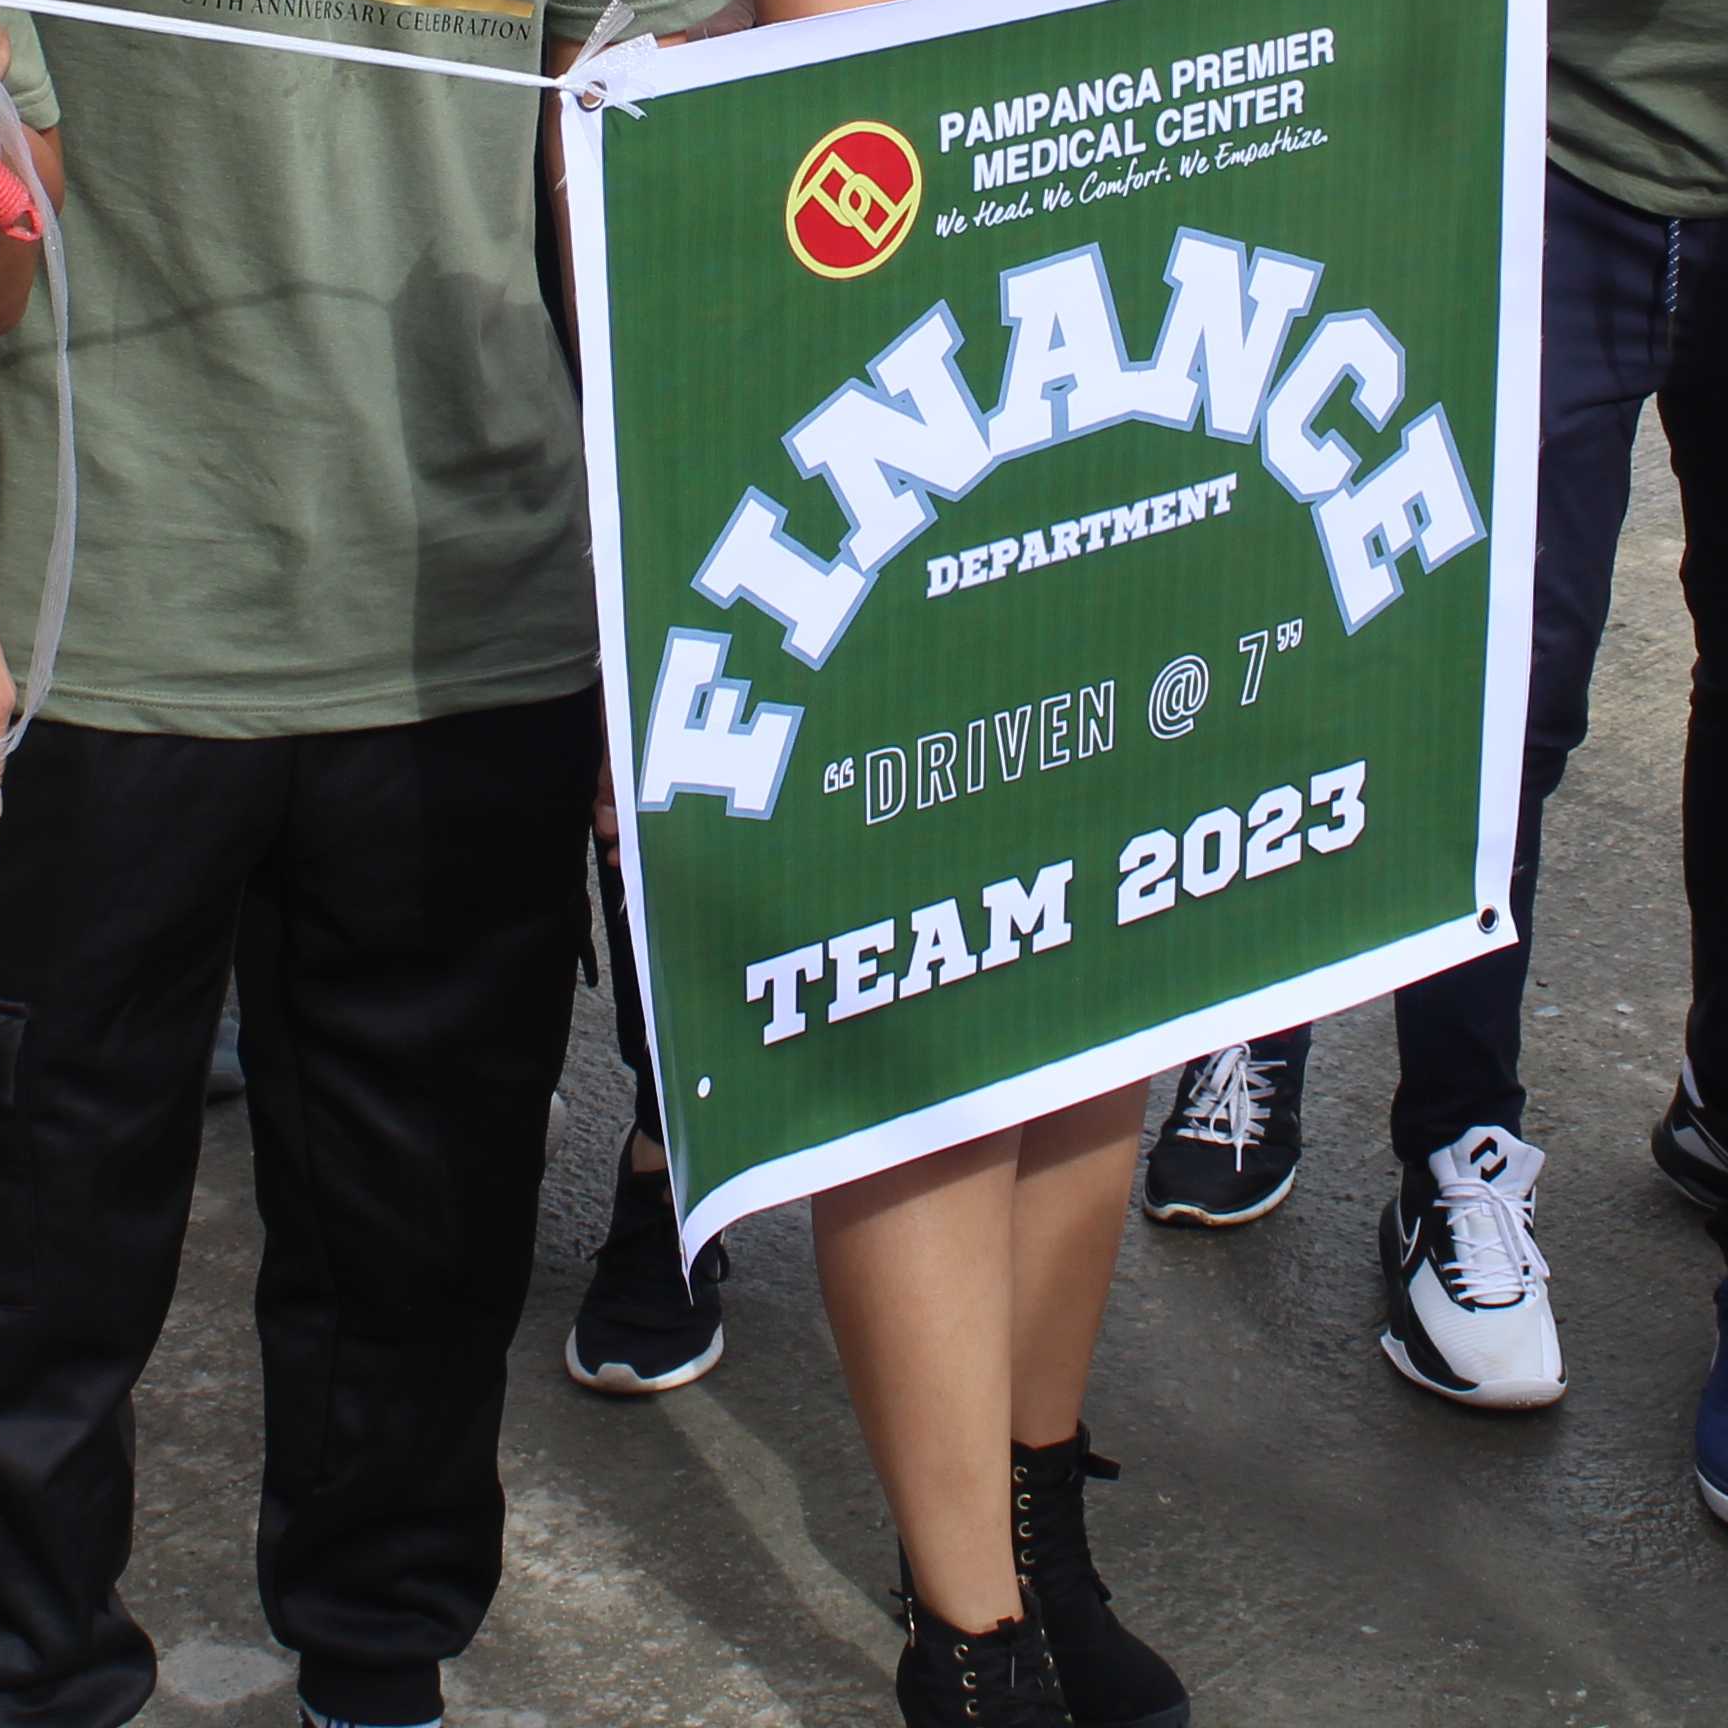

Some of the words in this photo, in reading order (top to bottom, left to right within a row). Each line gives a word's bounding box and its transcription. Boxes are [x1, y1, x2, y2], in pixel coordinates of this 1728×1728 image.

[396, 10, 533, 42] CELEBRATION
[939, 67, 1163, 154] PAMPANGA
[1170, 27, 1335, 100] PREMIER
[973, 118, 1147, 193] MEDICAL
[1155, 79, 1306, 147] CENTER
[935, 207, 968, 239] We
[972, 192, 1035, 229] Heal.
[1042, 182, 1074, 213] We
[1079, 157, 1172, 205] Comfort.
[1178, 149, 1210, 178] We
[1213, 125, 1330, 171] Empathize.
[637, 225, 1490, 822] FINANCE
[926, 473, 1238, 600] DEPARTMENT
[1147, 654, 1210, 741] @
[745, 858, 1074, 1047] TEAM
[1116, 759, 1367, 928] 2023
